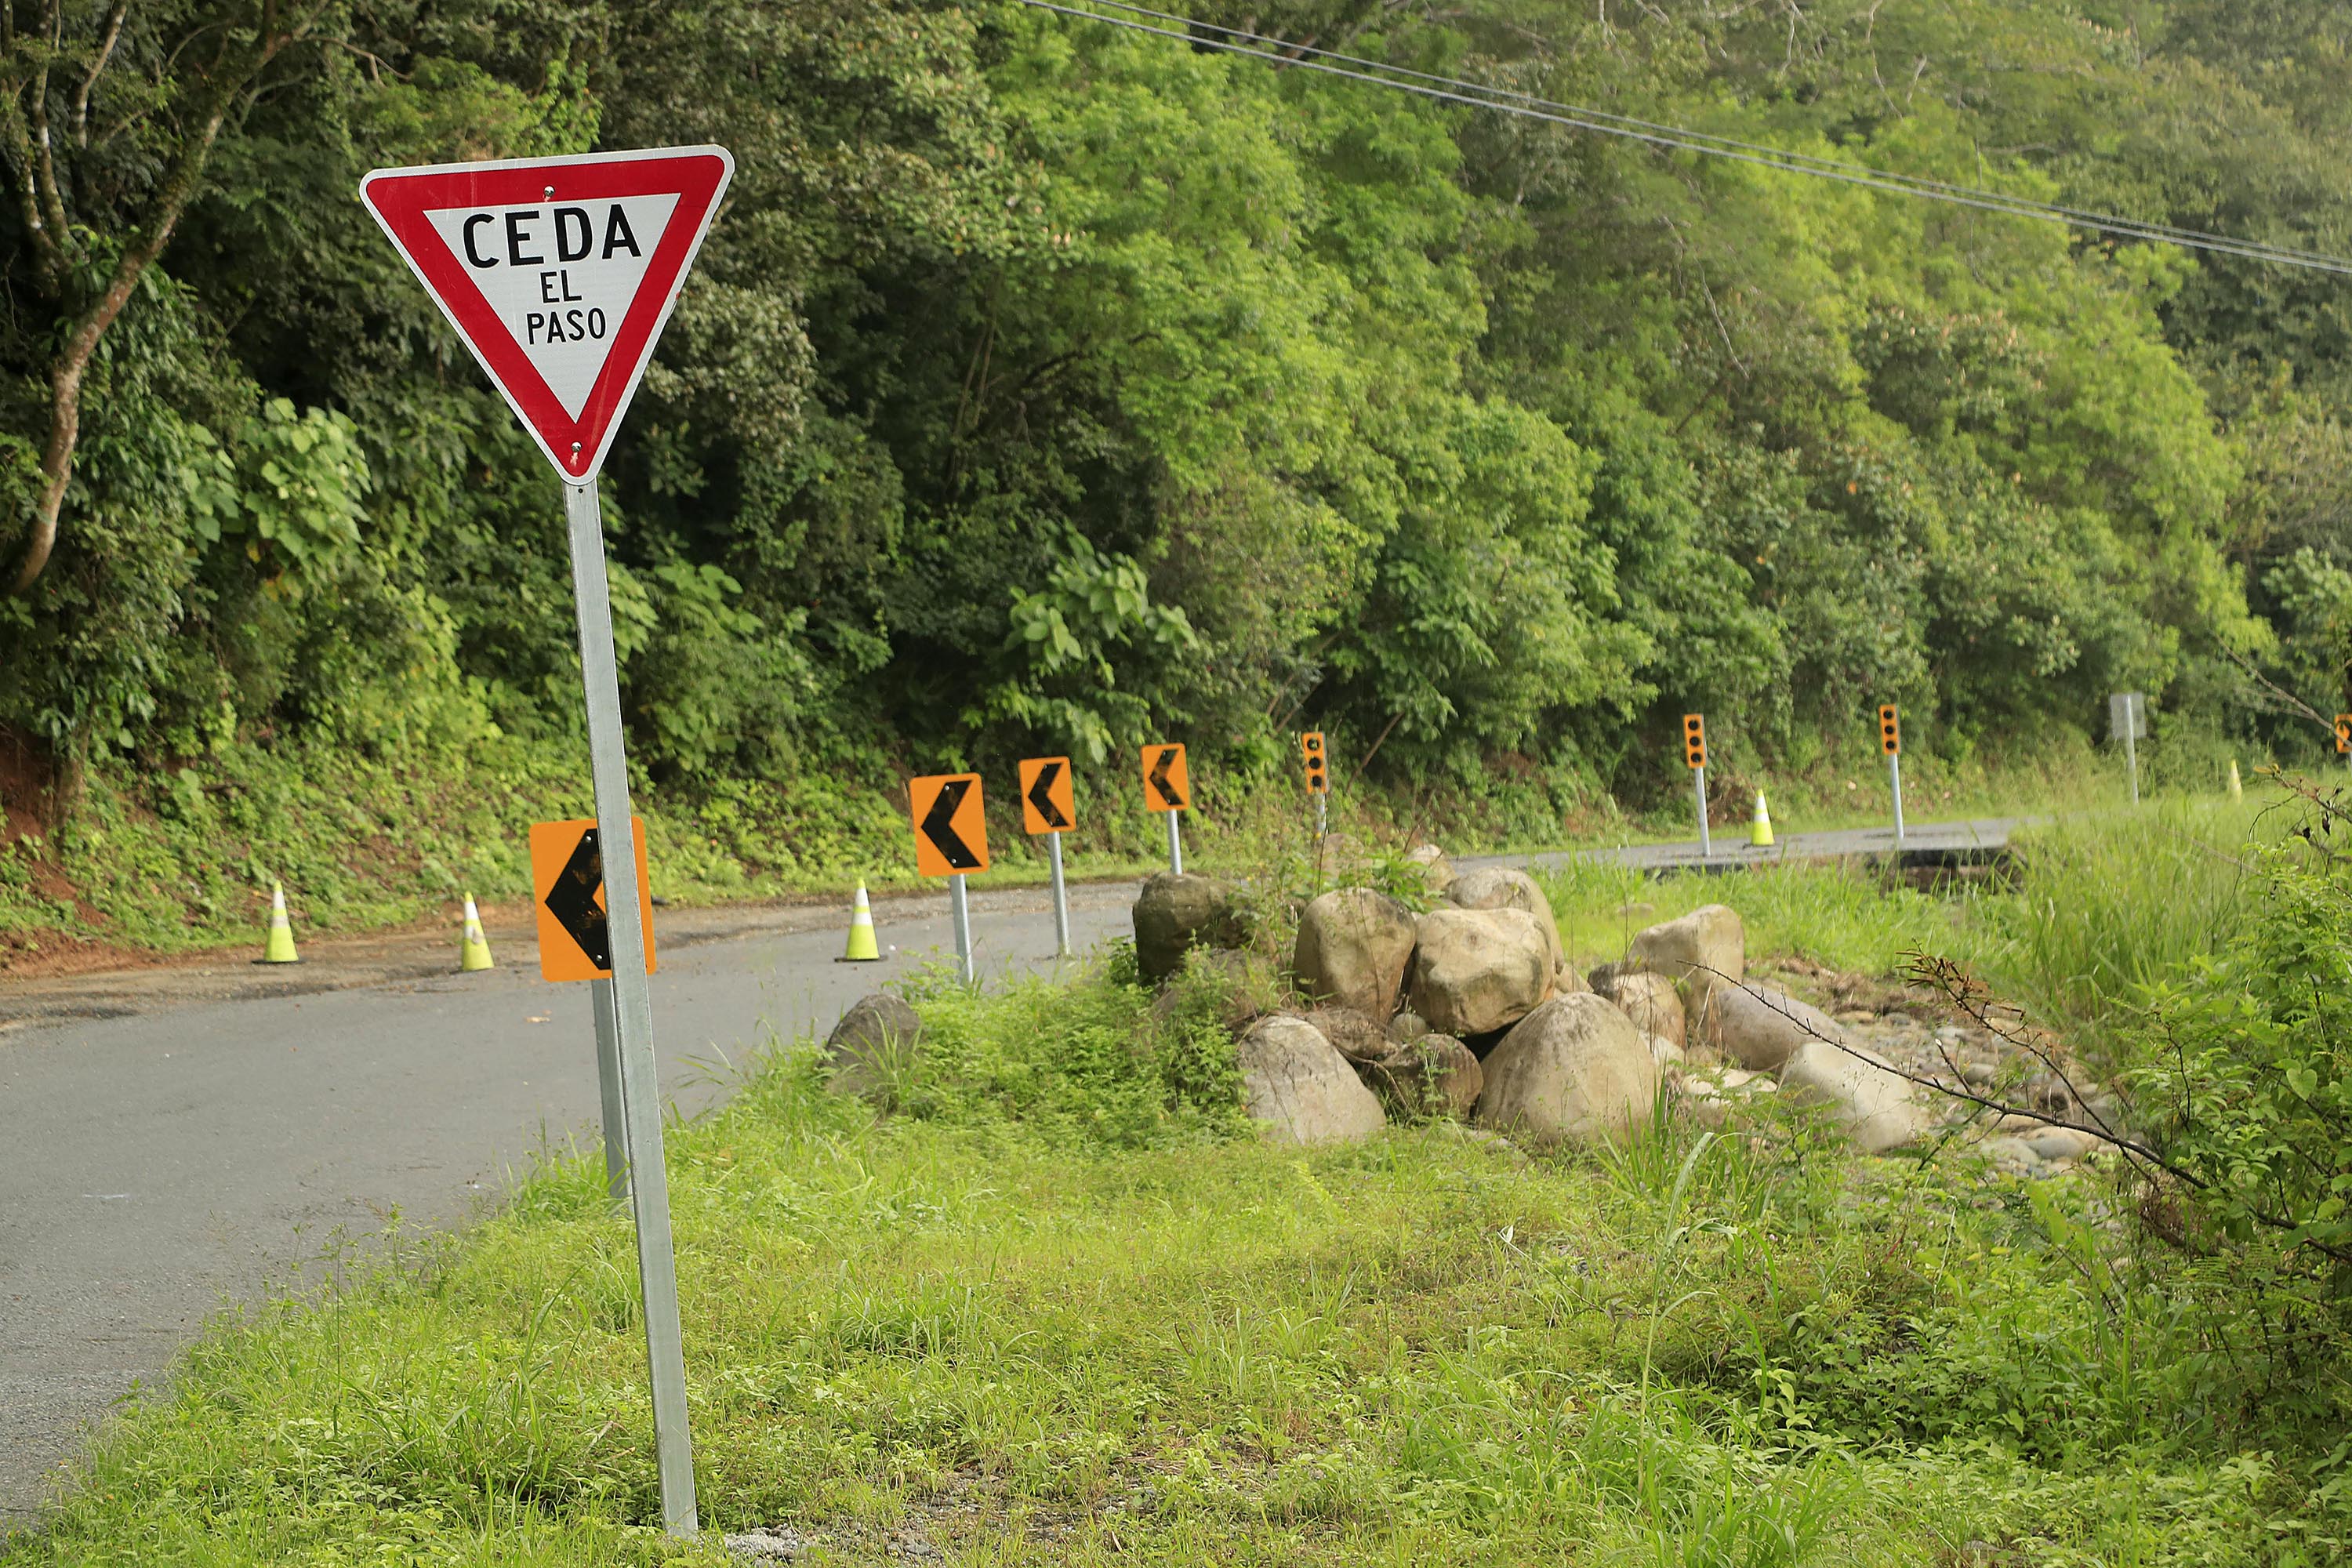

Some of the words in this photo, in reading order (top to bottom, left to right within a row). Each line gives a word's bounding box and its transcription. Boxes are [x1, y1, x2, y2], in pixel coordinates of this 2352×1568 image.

[463, 203, 642, 269] CEDA
[539, 269, 583, 303] EL
[526, 307, 606, 345] PASO
